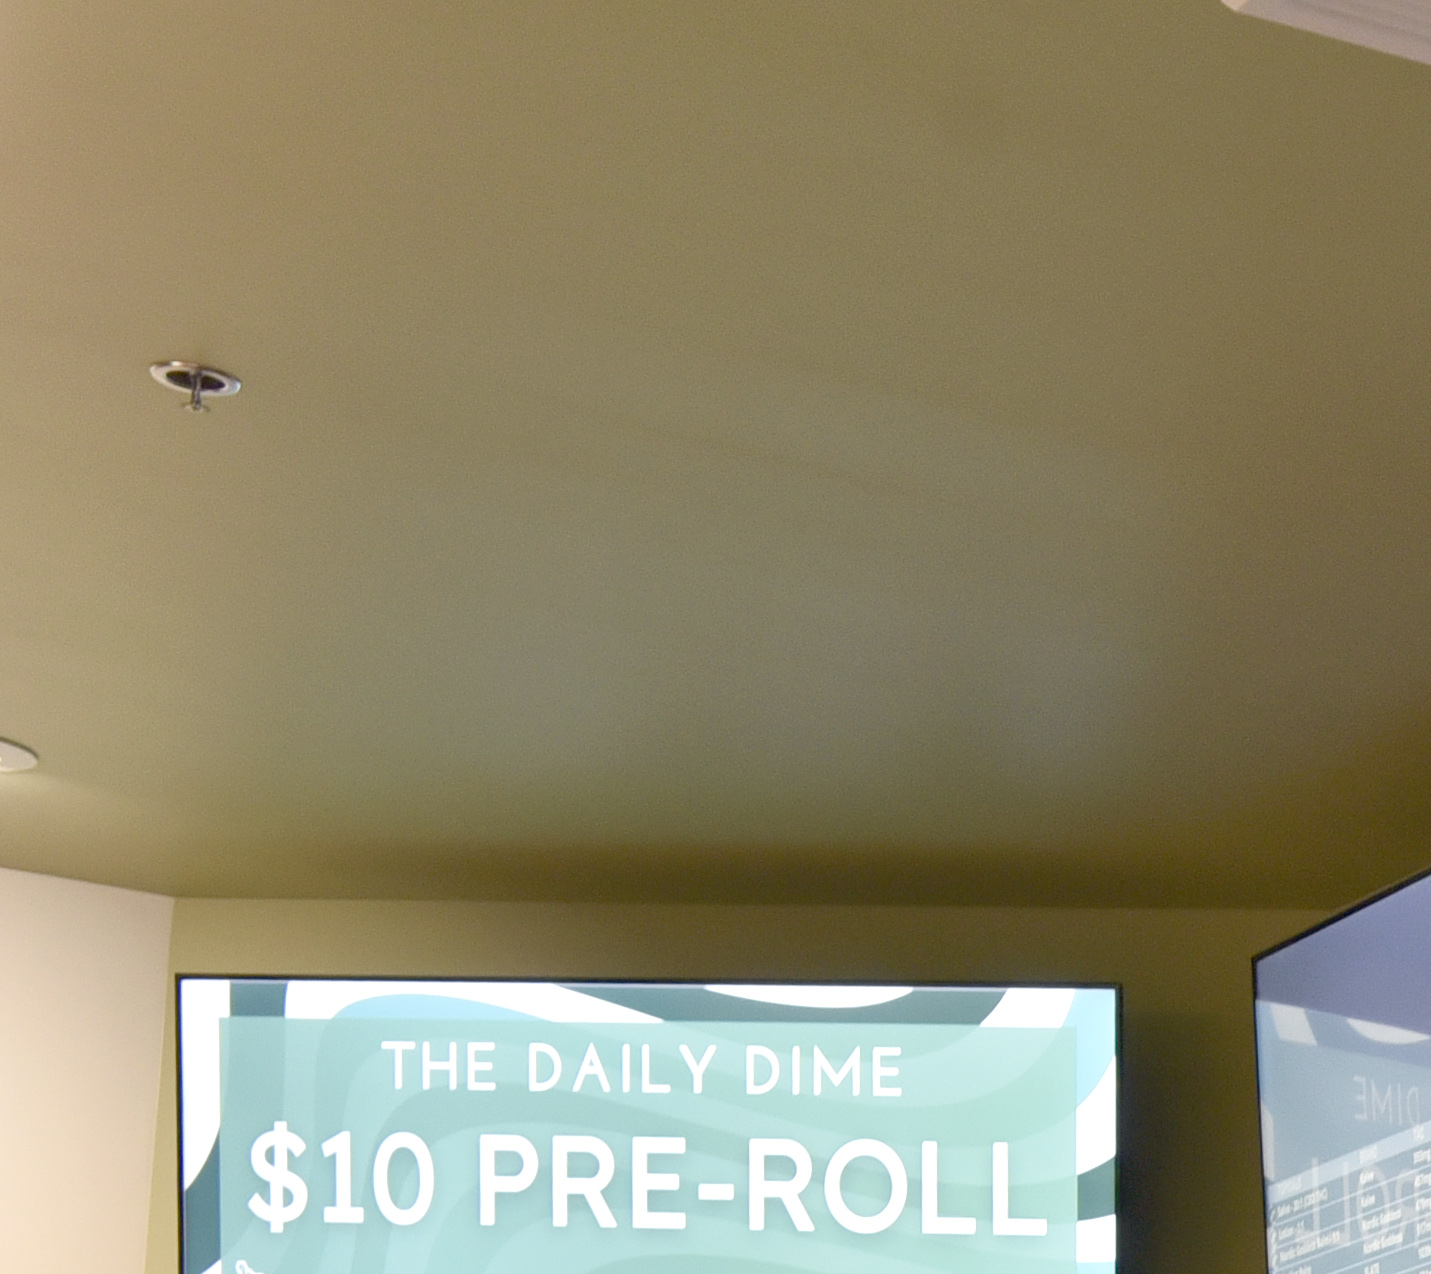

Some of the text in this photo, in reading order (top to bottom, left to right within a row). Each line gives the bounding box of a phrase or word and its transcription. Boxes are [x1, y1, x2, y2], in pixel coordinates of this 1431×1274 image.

[381, 1041, 902, 1096] THE DAILY DIME
[248, 1121, 1047, 1236] $10 PRE-ROLL
